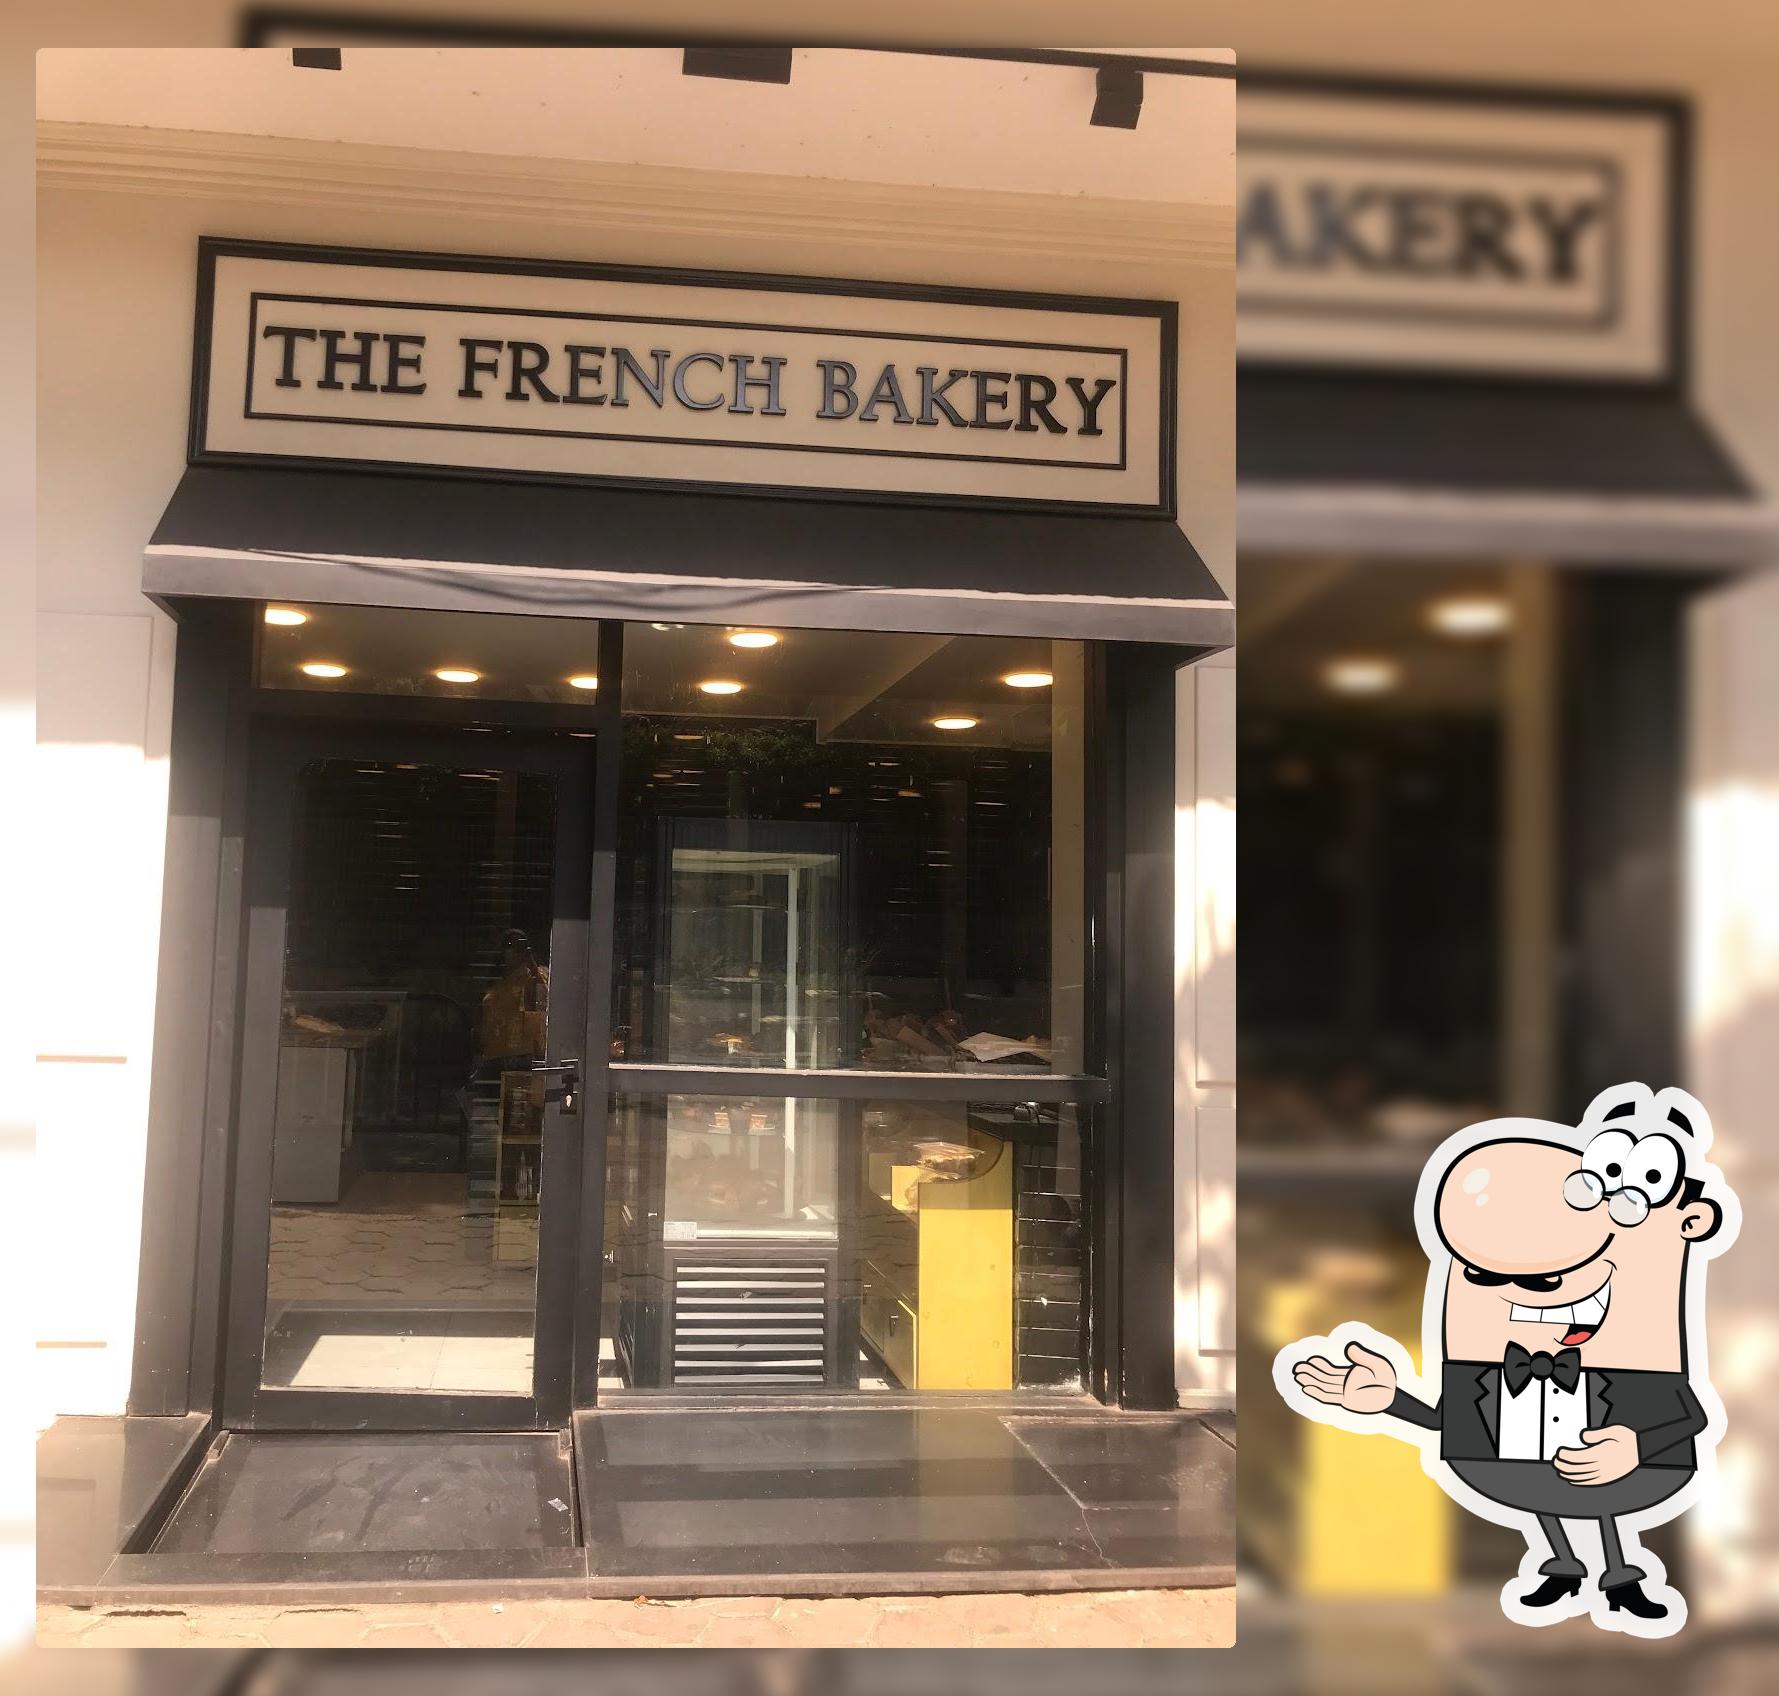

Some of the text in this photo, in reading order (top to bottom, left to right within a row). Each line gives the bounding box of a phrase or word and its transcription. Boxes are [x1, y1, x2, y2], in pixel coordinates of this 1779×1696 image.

[262, 325, 1117, 436] THE FRENCH BAKERY
